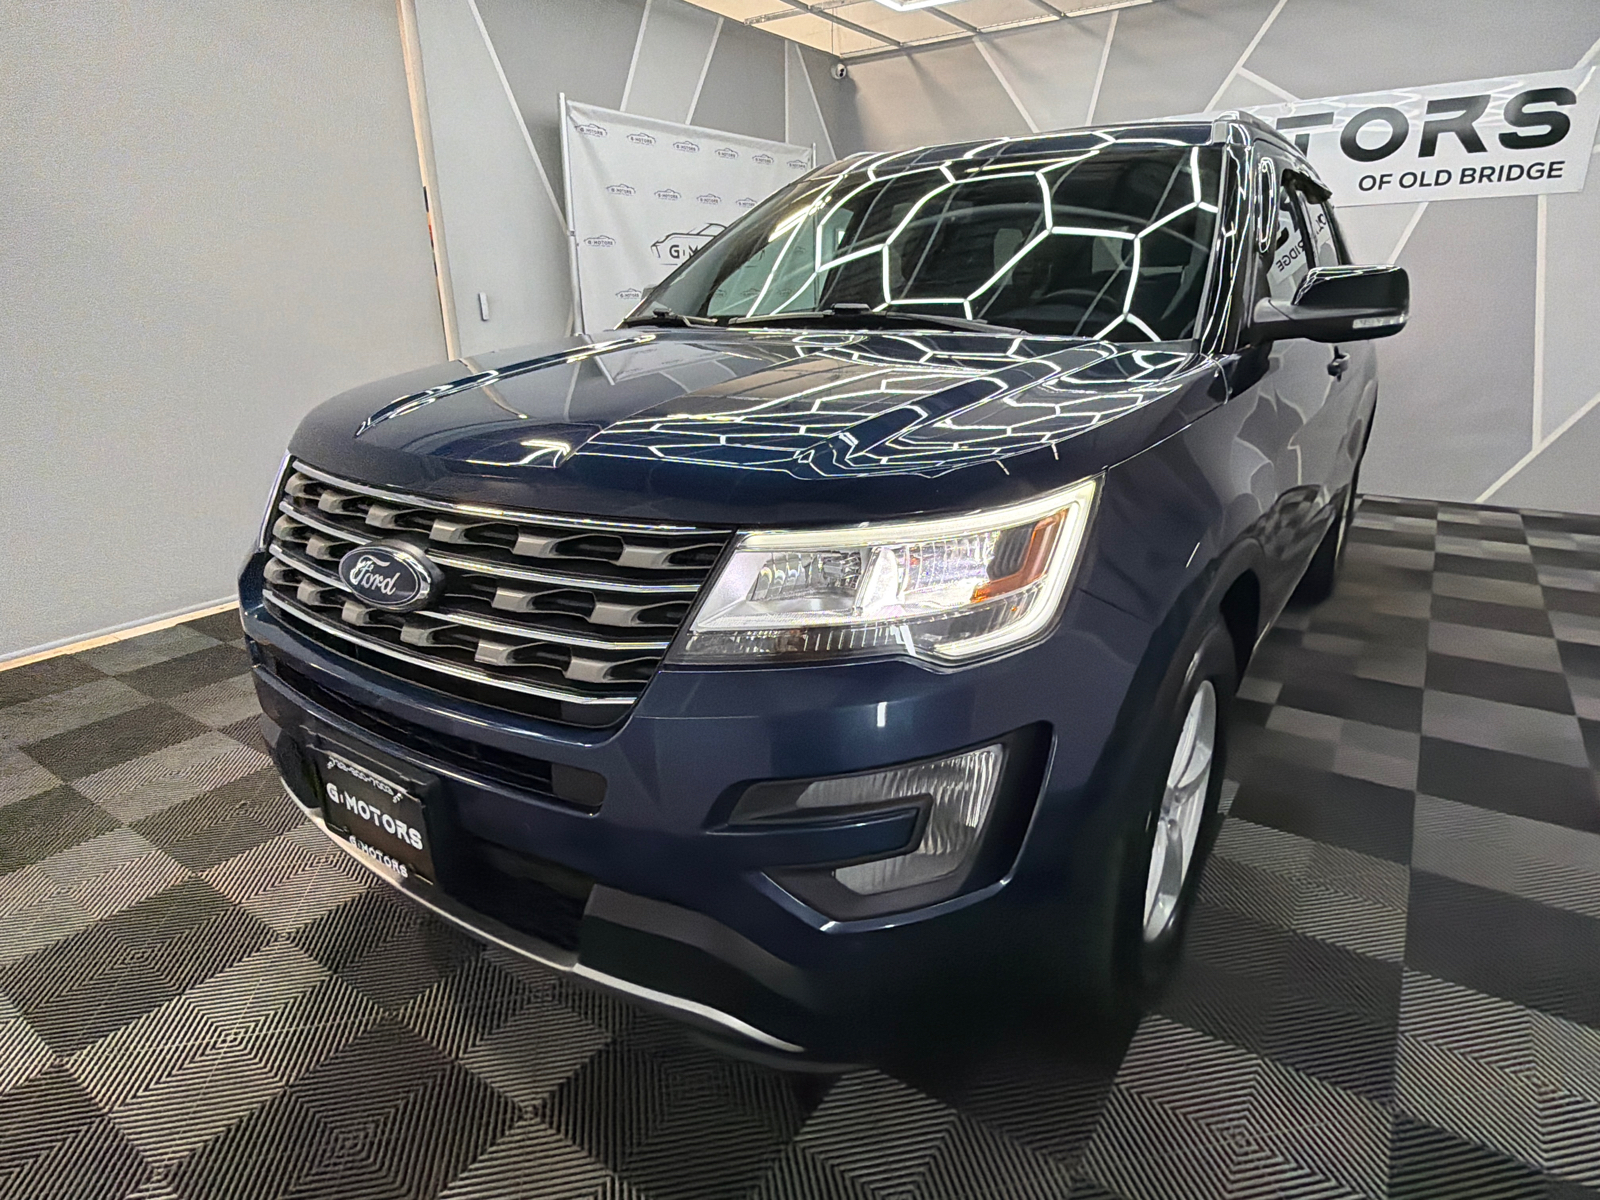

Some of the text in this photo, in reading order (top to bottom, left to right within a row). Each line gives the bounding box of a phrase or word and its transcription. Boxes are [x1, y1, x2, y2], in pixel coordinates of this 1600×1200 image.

[1358, 160, 1566, 192] OF OLD BRIDGE
[349, 554, 401, 596] Ford
[344, 790, 424, 850] MOTORS
